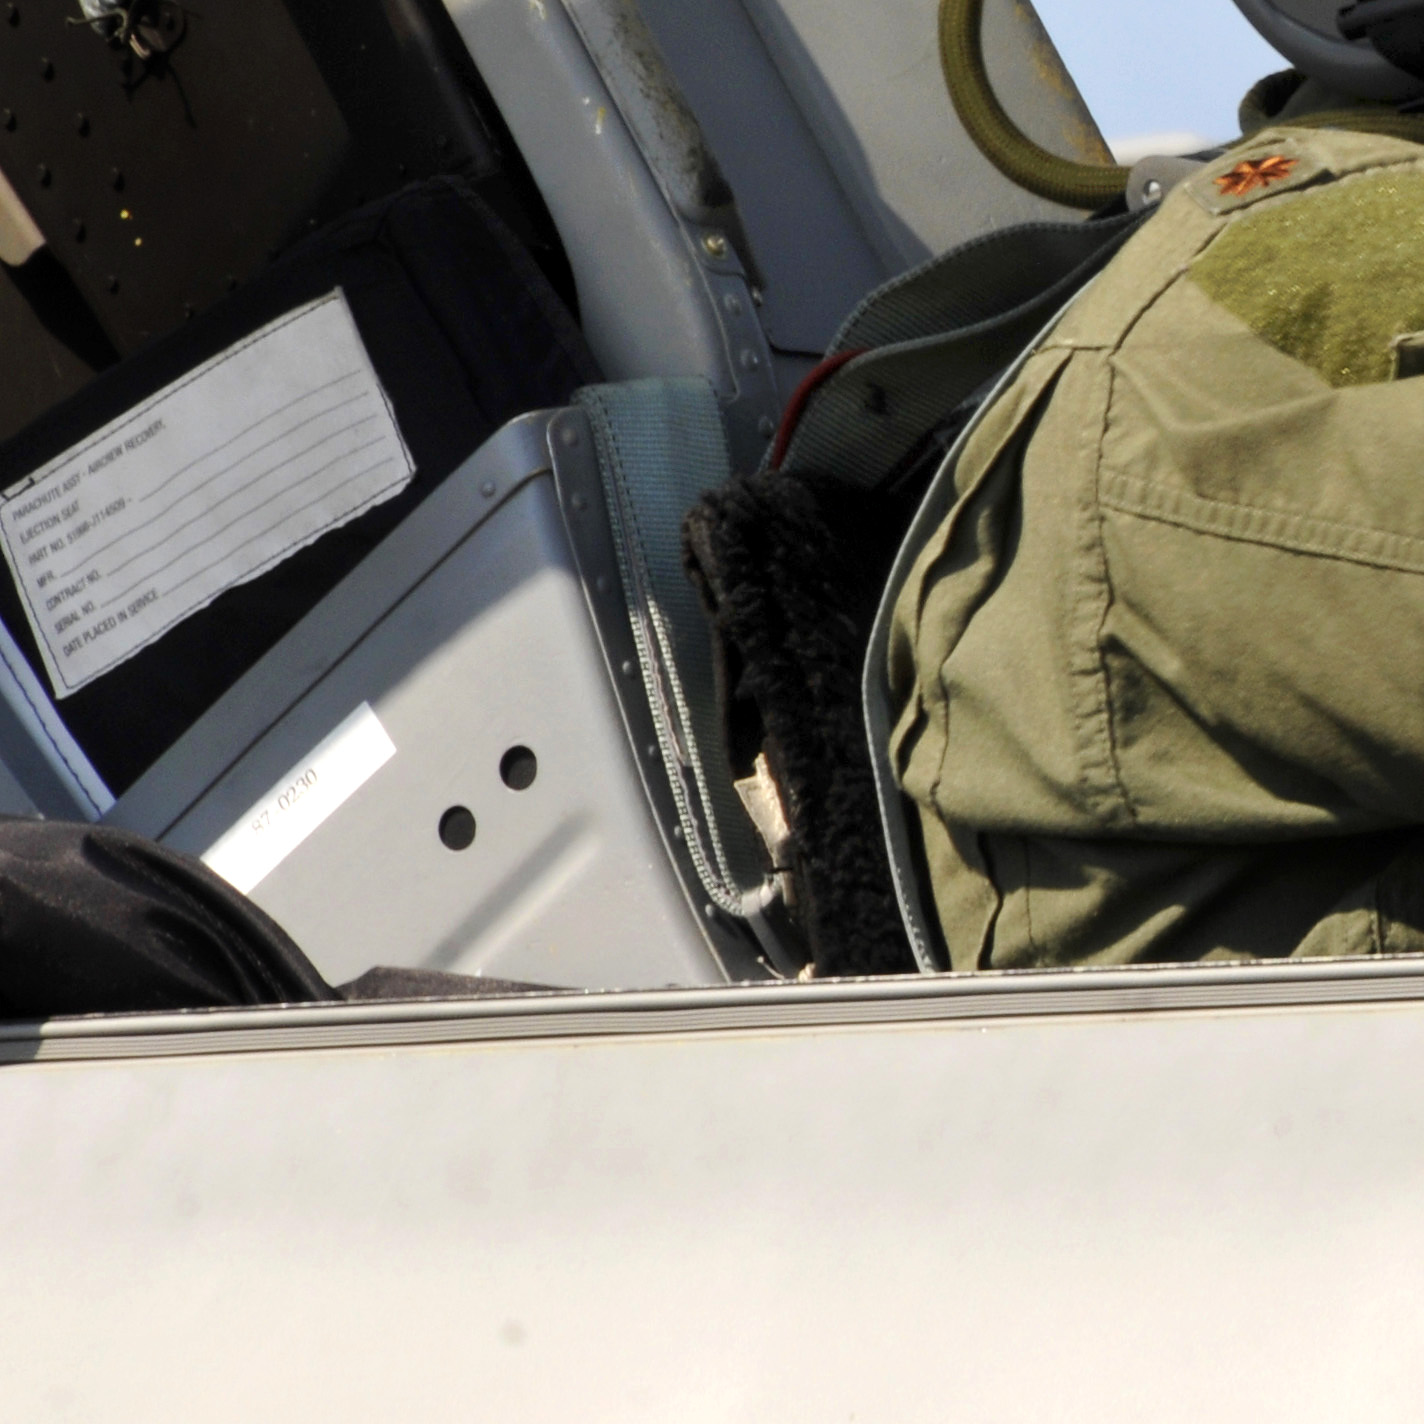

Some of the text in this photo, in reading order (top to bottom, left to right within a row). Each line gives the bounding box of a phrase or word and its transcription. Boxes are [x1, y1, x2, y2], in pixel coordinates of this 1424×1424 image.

[12, 486, 62, 521] PARACHUTE
[88, 444, 124, 475] AIRCREW
[19, 499, 81, 545] EJECTION SEAT
[28, 546, 49, 566] PART
[46, 577, 87, 611] CONTRACT
[54, 610, 81, 634] SERIAL
[62, 636, 84, 658] DATE
[84, 616, 117, 646] PLACED
[128, 587, 159, 617] SERVICE
